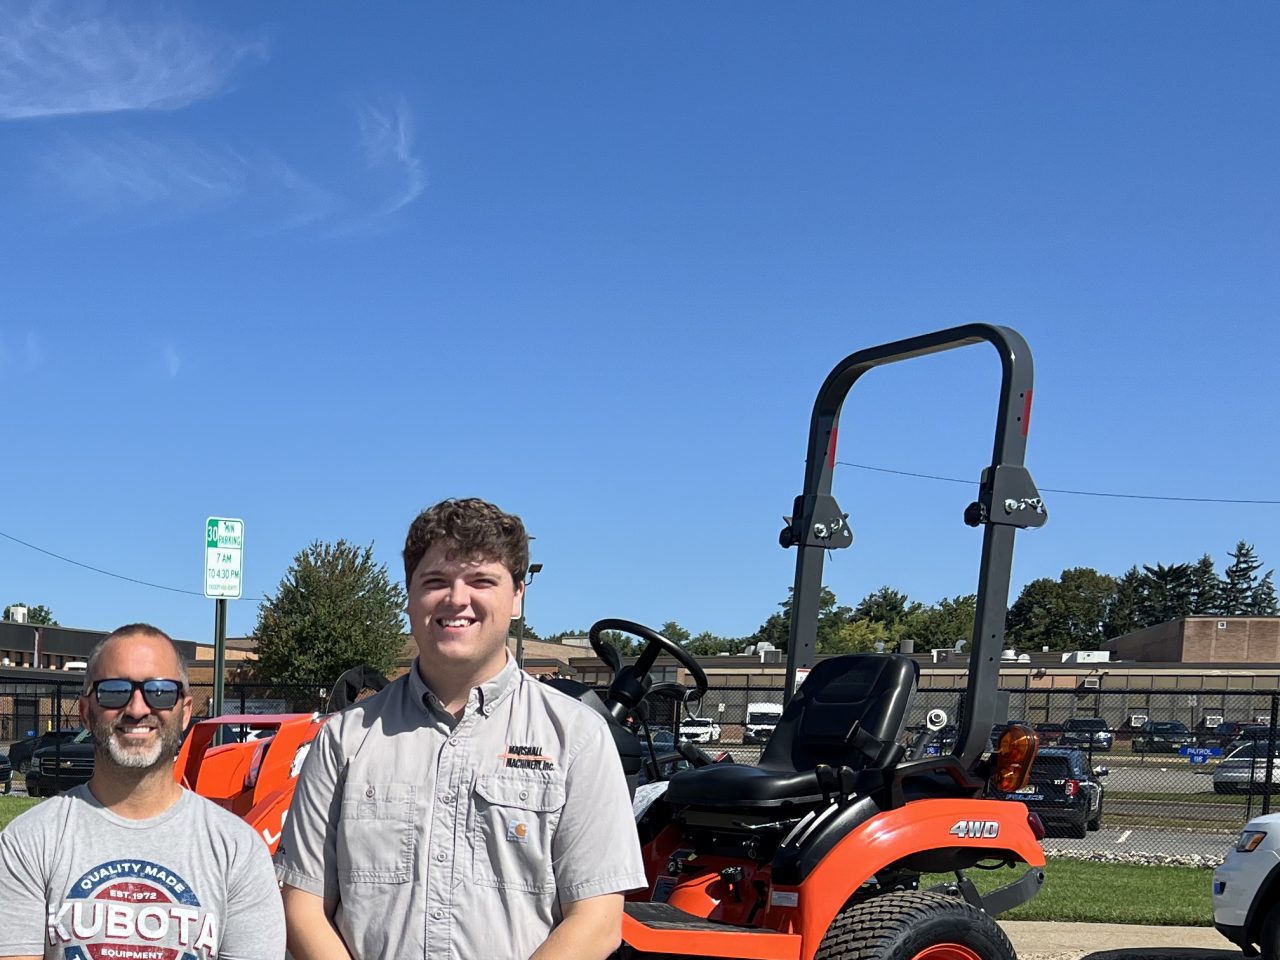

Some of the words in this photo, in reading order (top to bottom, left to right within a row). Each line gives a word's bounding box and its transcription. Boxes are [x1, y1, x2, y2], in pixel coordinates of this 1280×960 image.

[208, 526, 217, 541] 30
[219, 535, 240, 546] PARKING
[222, 554, 231, 563] AM
[508, 745, 542, 756] MARSHALL
[949, 820, 999, 838] 4WD
[80, 863, 141, 890] QUALITY
[145, 866, 186, 893] MADE
[110, 890, 131, 899] EST.
[132, 892, 157, 900] 1972
[48, 902, 219, 958] KUBOTA
[101, 949, 163, 959] EQUIPMENT
